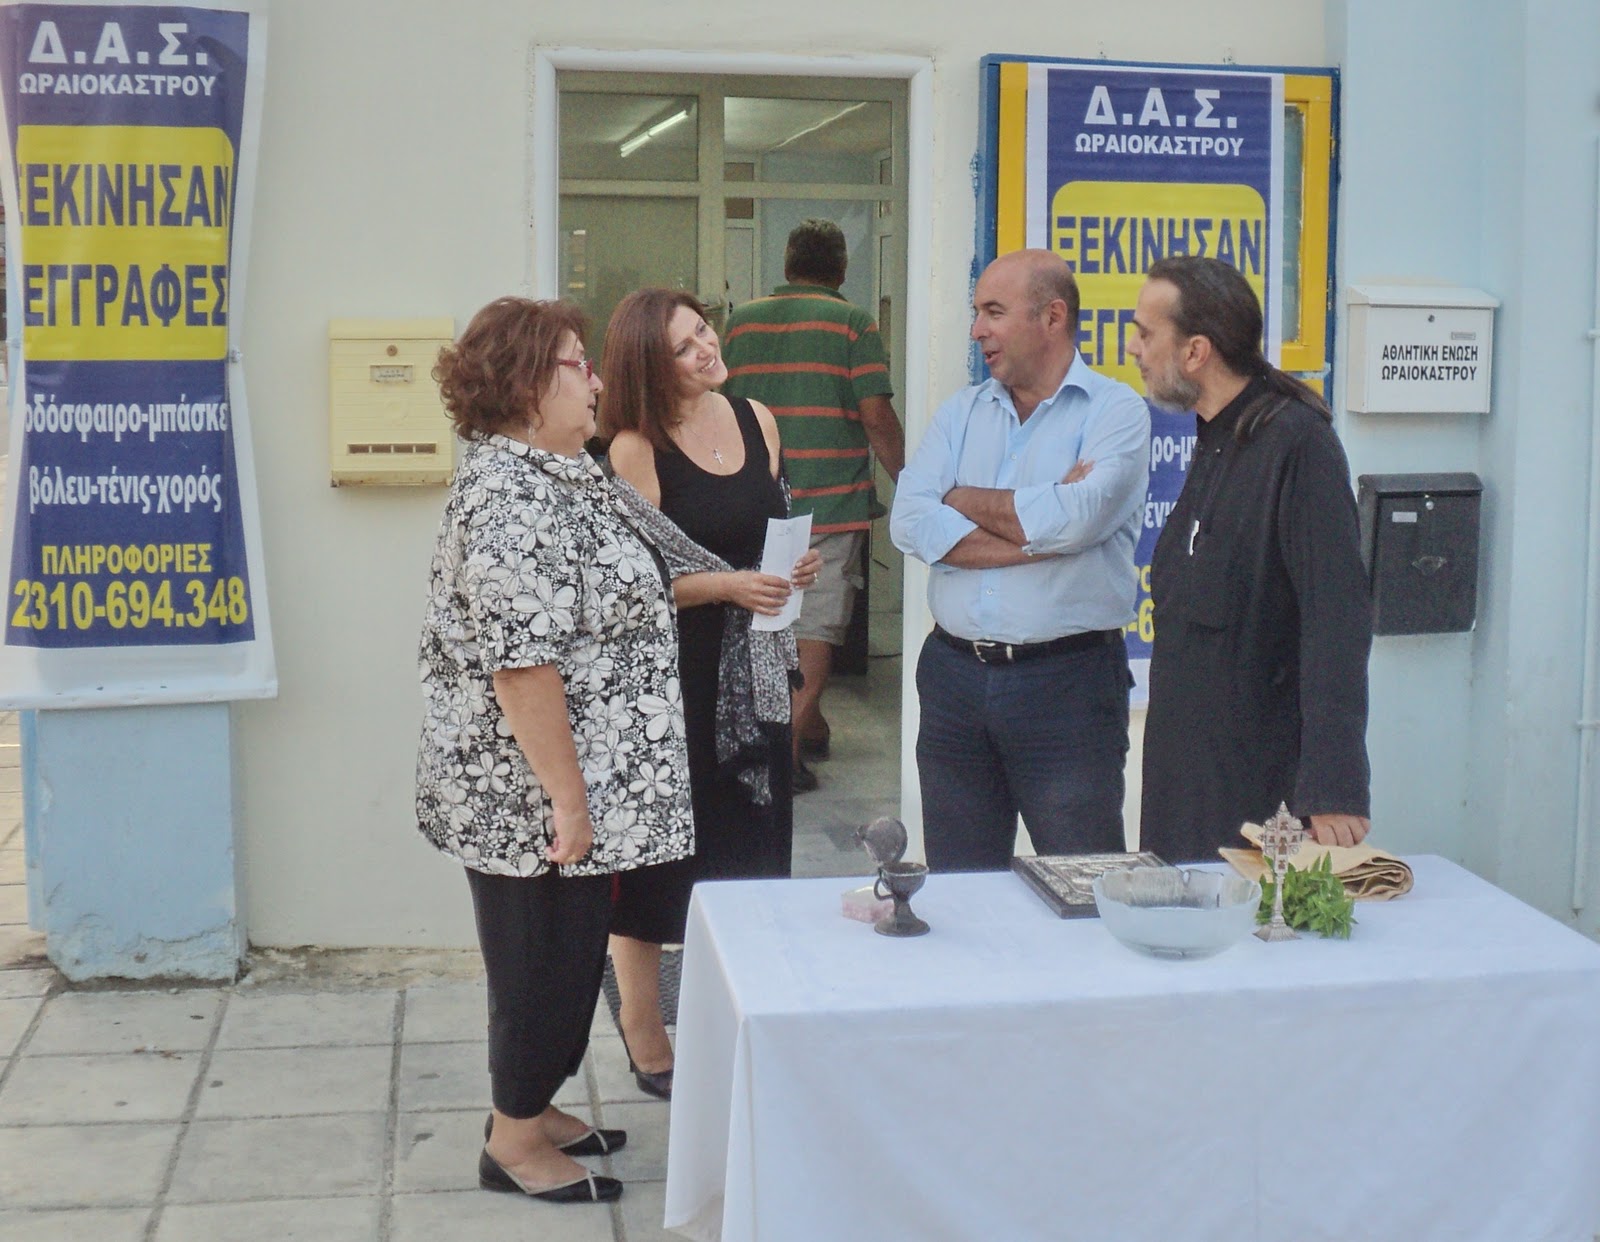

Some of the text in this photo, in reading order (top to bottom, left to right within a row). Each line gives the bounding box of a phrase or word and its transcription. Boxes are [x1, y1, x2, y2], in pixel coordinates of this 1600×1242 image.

[28, 21, 208, 65] Δ.Α.Σ.
[19, 73, 216, 96] ΩΡΑΙΟΚΑΣΤΡΟΥ
[1084, 85, 1238, 128] Δ.Α.Σ.
[1075, 133, 1244, 156] ΩΡΑΙΟΚΑΣΤΡΟΥ
[19, 163, 229, 227] ΕΚΙΝΗΣΑΝ
[1057, 216, 1261, 275] ΞΕΚΙΝΗΣΑΝ
[23, 263, 227, 327] ΕΓΓΡΑΦΕΣ
[1382, 344, 1479, 361] ΑΘΛΗΤΙΚΗ ΕΝΩΣΗ
[1382, 365, 1478, 380] ΩΡΑΙΟΚΑΣΤΡΟΥ
[41, 543, 213, 575] ΠΛΗΡΟΦΟΡΙΕΣ
[11, 577, 248, 630] 2310-694.348
